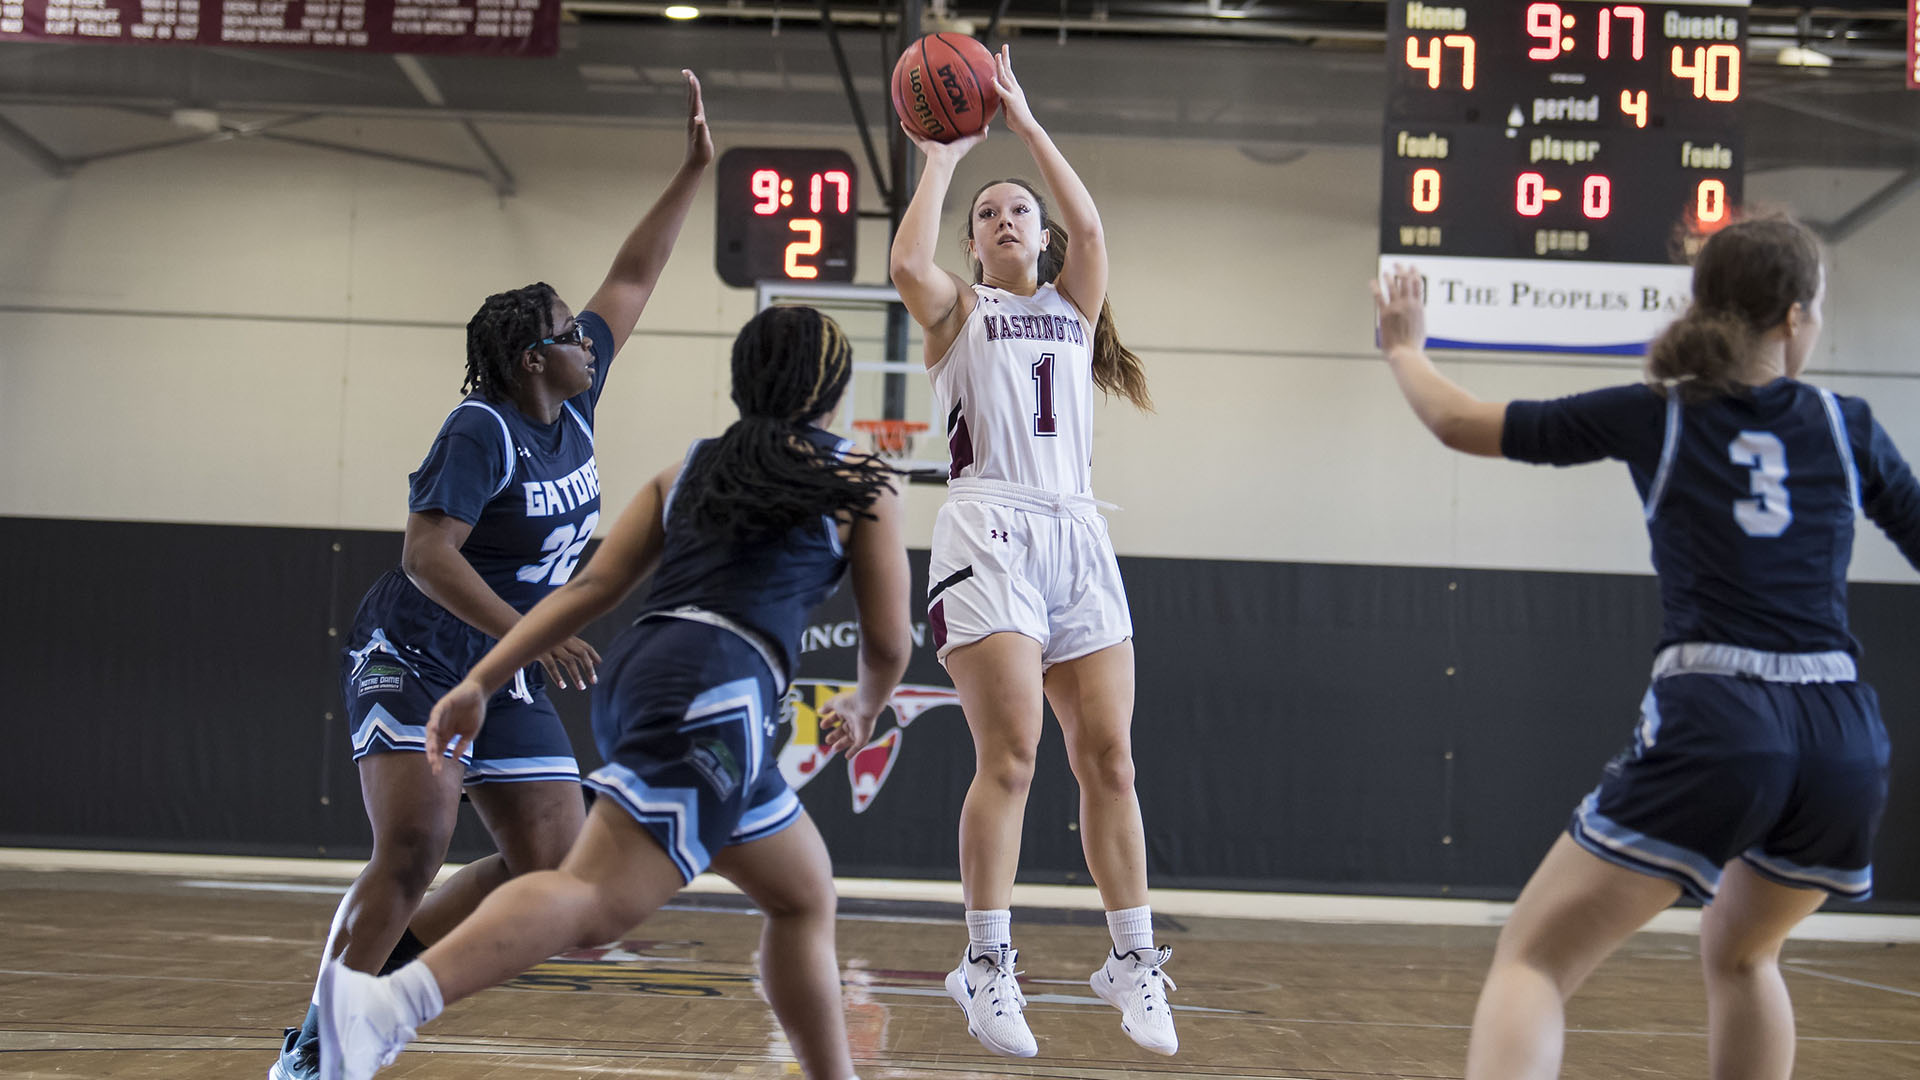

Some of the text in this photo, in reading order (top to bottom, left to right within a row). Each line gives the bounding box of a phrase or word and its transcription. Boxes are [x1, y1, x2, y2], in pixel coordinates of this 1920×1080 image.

[1406, 3, 1466, 30] Home
[1526, 2, 1645, 61] 9:17
[1664, 10, 1738, 40] Guests
[1406, 35, 1476, 90] 47
[1671, 44, 1740, 102] 40
[909, 65, 945, 135] Wilson
[936, 64, 970, 115] NCAA
[1533, 95, 1600, 124] period
[1620, 89, 1648, 128] 4
[1398, 131, 1449, 158] fouls
[1530, 136, 1600, 164] player
[1682, 142, 1732, 169] fouls
[751, 168, 850, 216] 9:17
[1411, 168, 1441, 213] 0
[1583, 174, 1611, 219] 0
[1697, 178, 1725, 223] 0
[784, 218, 823, 280] 2
[1400, 226, 1442, 247] won
[1535, 229, 1590, 256] game
[1440, 280, 1688, 312] THE PEOPLES BA
[1031, 353, 1058, 437] 1
[1729, 431, 1792, 537] 3
[515, 509, 600, 586] 32
